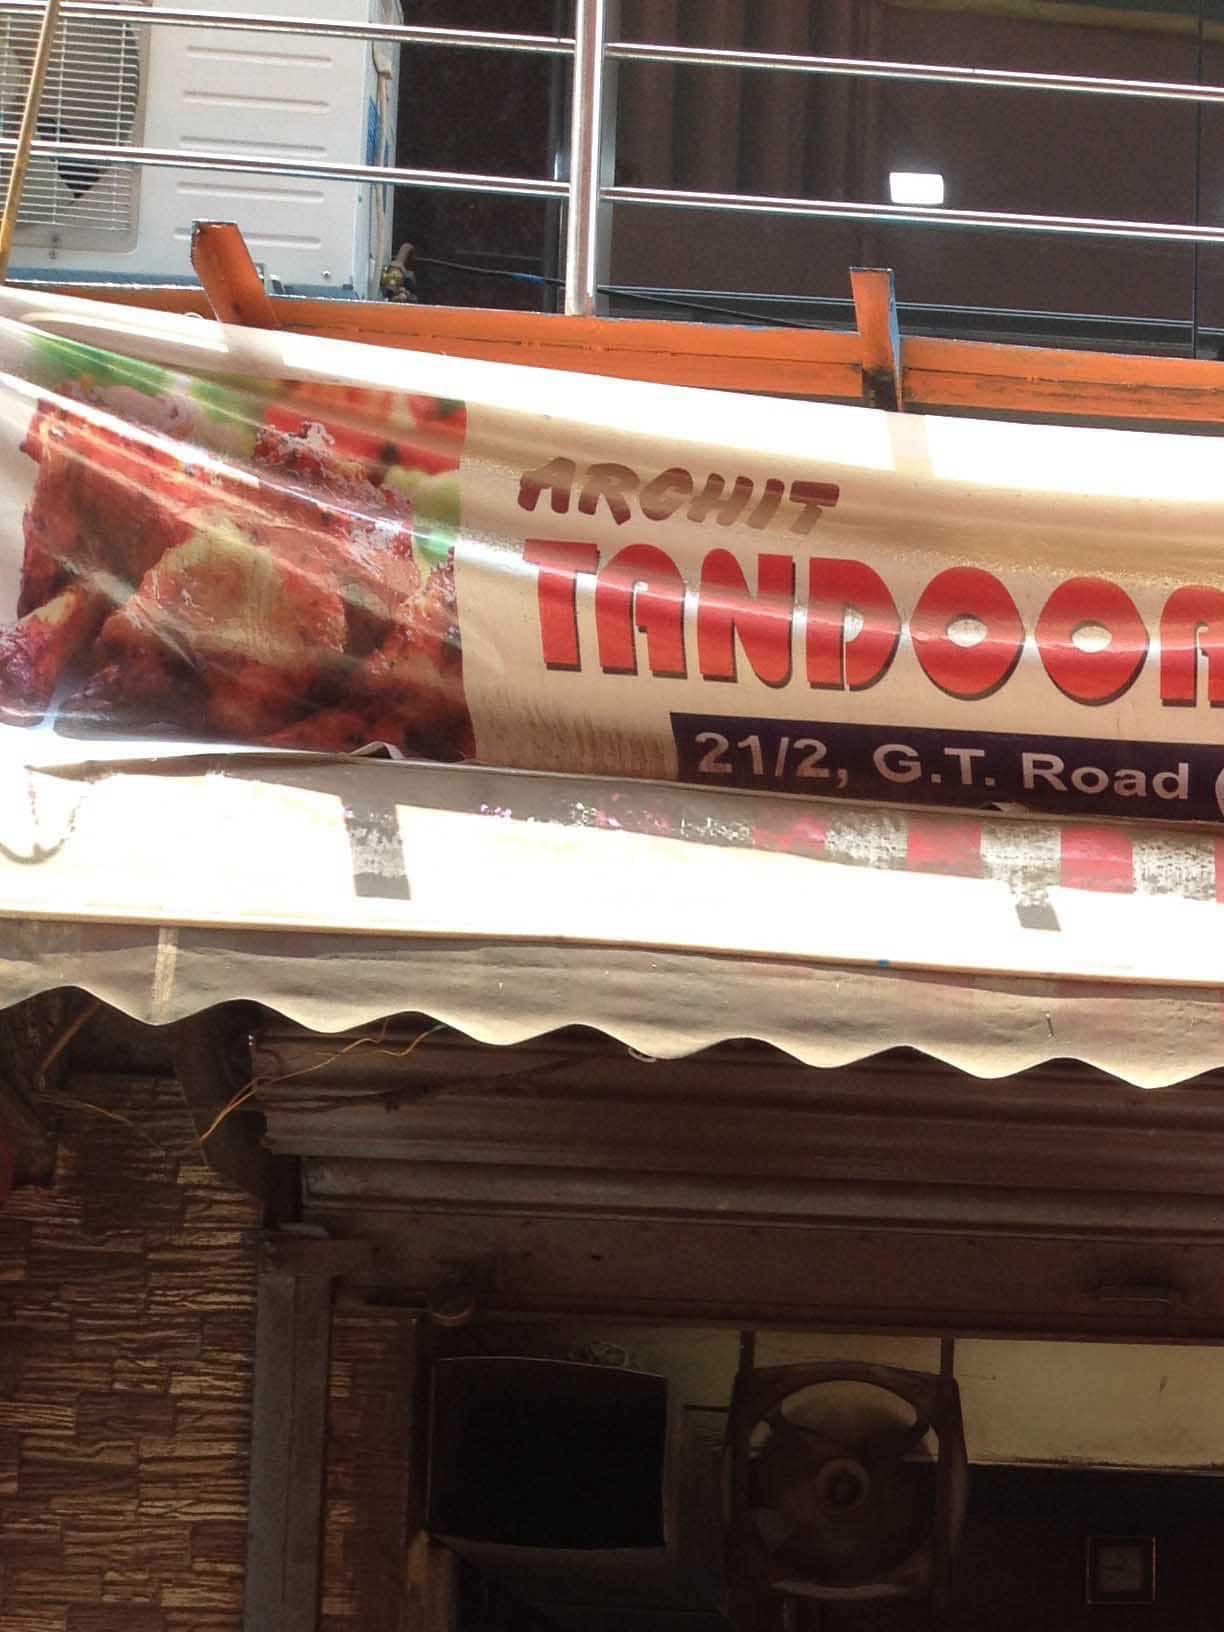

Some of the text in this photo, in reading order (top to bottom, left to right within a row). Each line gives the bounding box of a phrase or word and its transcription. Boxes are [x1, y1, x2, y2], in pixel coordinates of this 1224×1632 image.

[517, 456, 839, 535] ARCHIT
[694, 732, 848, 789] 21/2,
[873, 743, 996, 788] G.T.
[1022, 752, 1189, 800] Road
